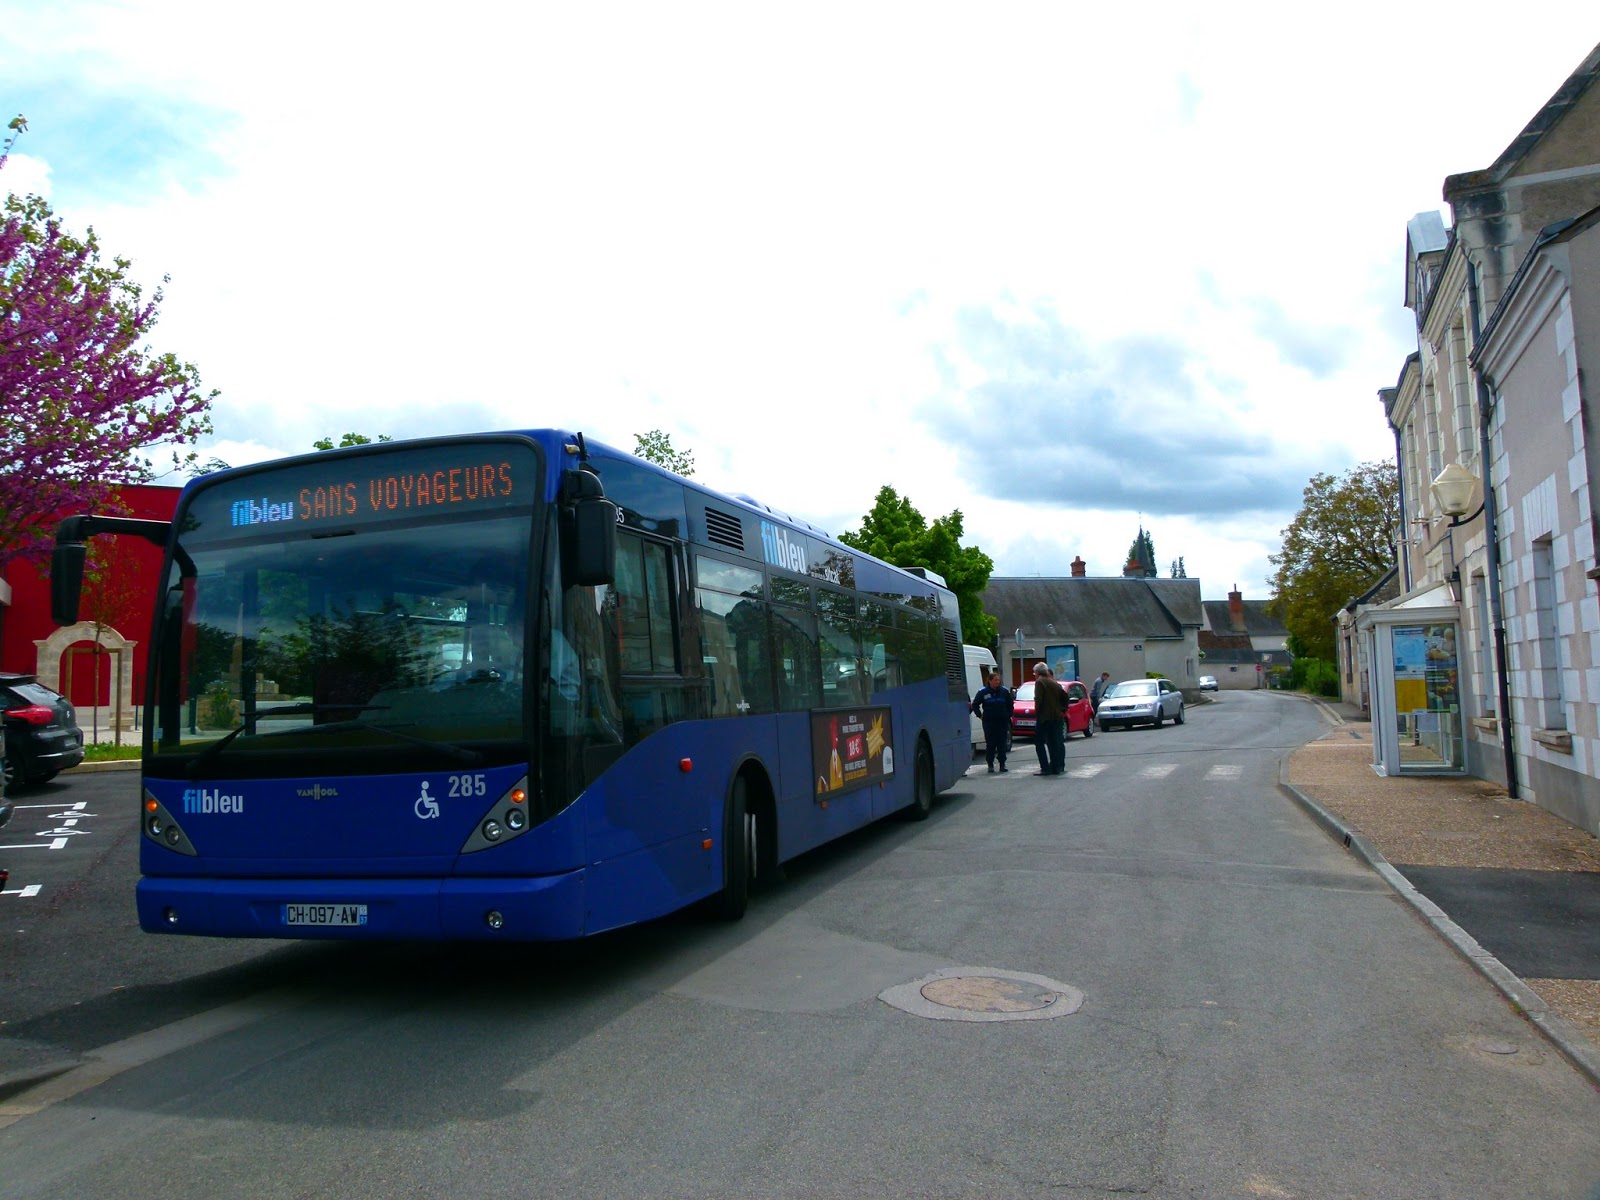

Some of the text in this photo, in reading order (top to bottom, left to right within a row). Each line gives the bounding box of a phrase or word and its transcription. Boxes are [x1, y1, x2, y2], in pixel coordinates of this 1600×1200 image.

[230, 463, 513, 526] filbleu SANS VOYAGEURS
[761, 520, 807, 574] filbleu
[448, 774, 486, 798] 285
[182, 788, 244, 814] filbleu
[287, 905, 359, 924] CH-097-AW
